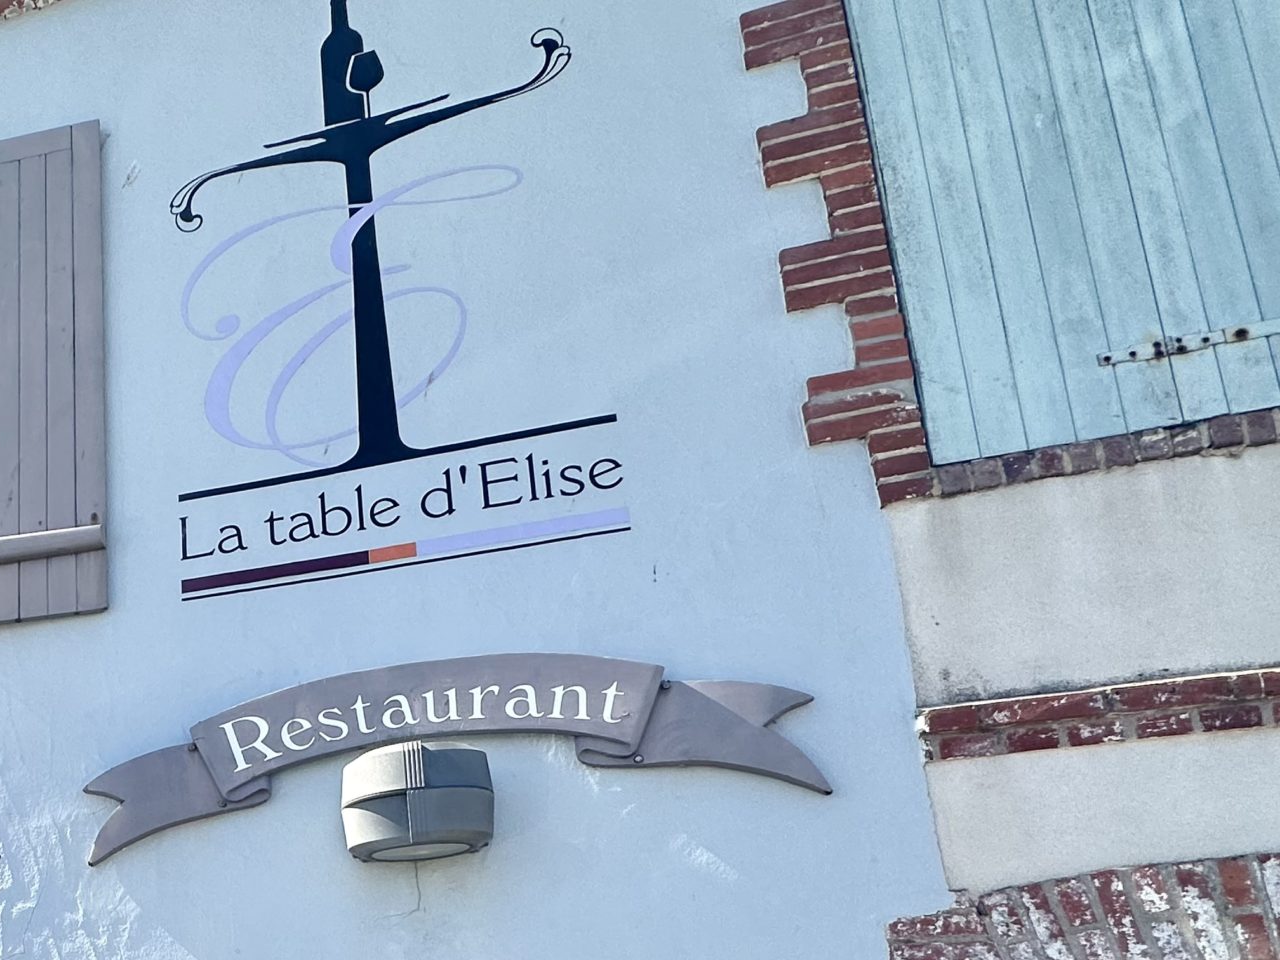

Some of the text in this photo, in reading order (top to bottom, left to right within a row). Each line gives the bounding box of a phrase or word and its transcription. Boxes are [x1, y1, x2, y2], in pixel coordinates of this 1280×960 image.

[179, 452, 625, 561] La table d'Elise
[219, 680, 629, 774] Restaurant
